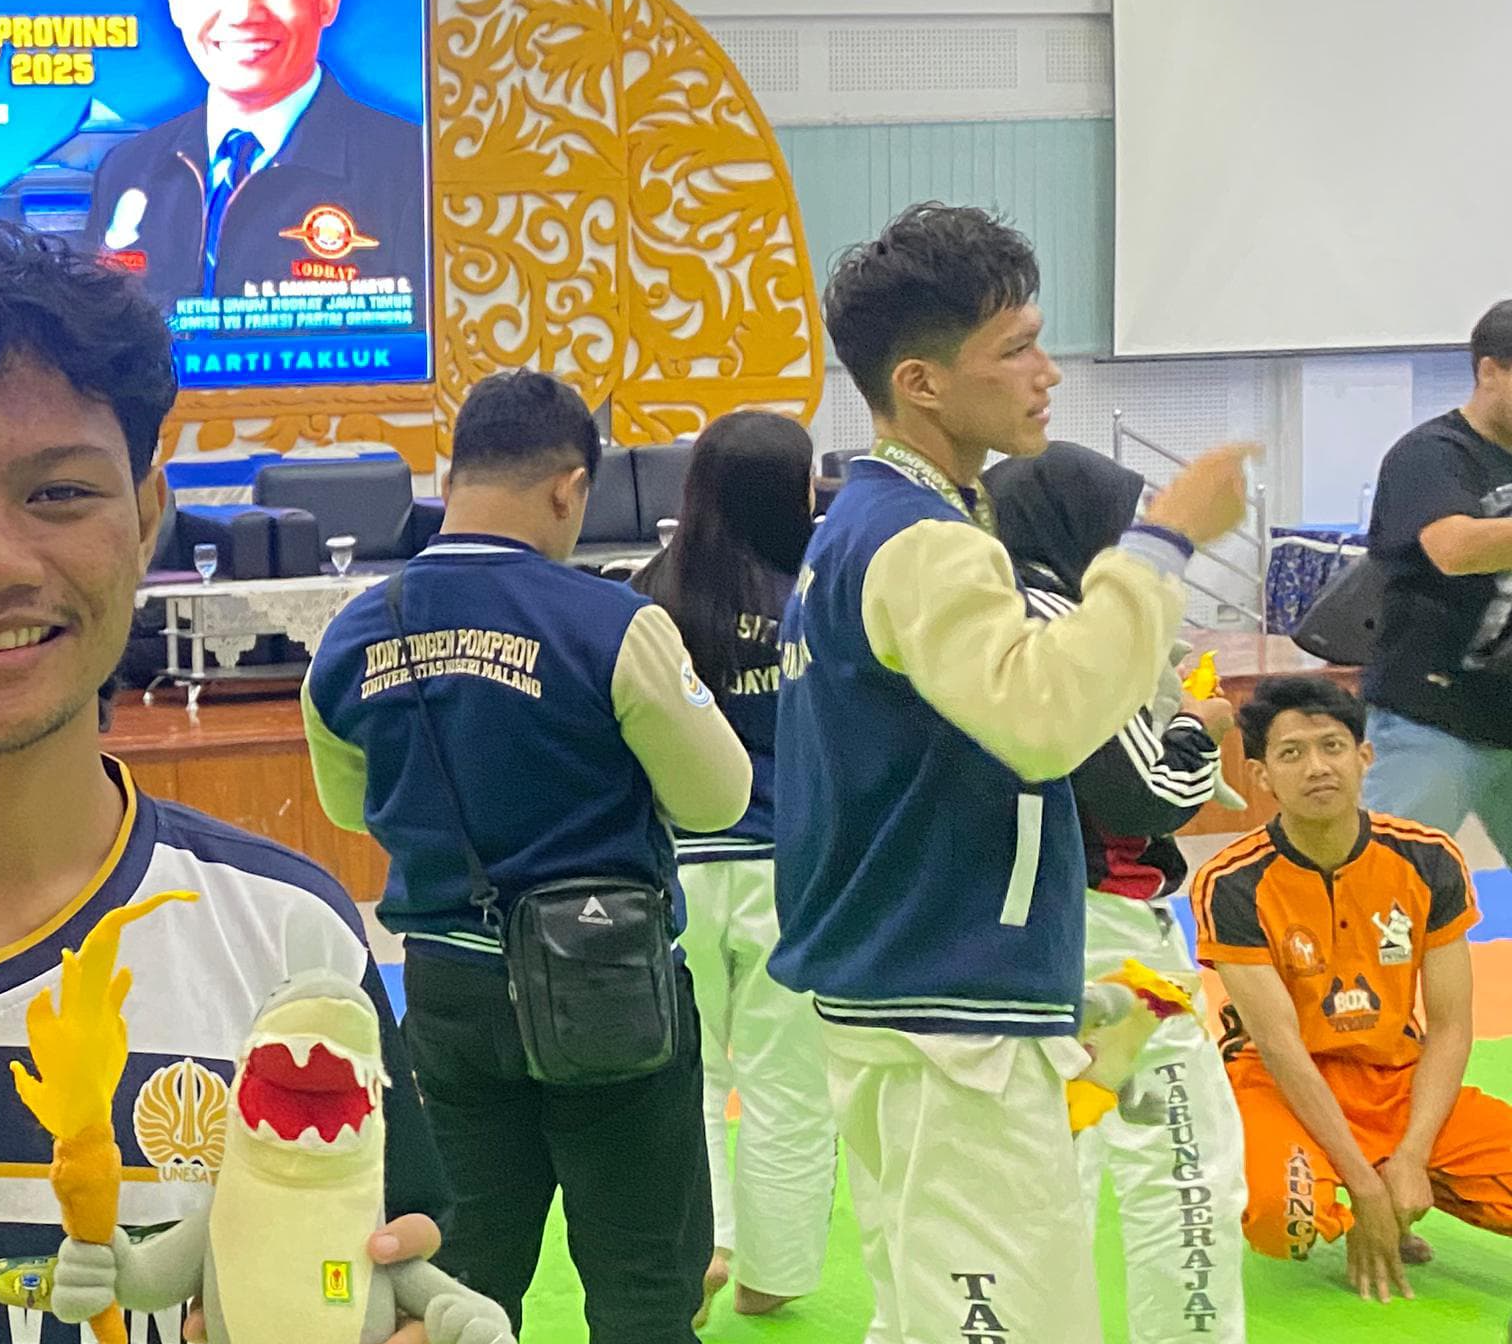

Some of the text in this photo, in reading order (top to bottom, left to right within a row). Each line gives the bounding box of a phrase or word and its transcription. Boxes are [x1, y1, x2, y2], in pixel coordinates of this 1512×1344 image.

[10, 52, 96, 87] 2025
[185, 353, 272, 374] RARTI
[279, 348, 391, 370] TAKLUK
[455, 628, 541, 674] POMPROV
[480, 661, 542, 699] MALANG
[162, 1166, 209, 1183] UNESA
[1154, 1061, 1217, 1333] TARUNG DERAJAT
